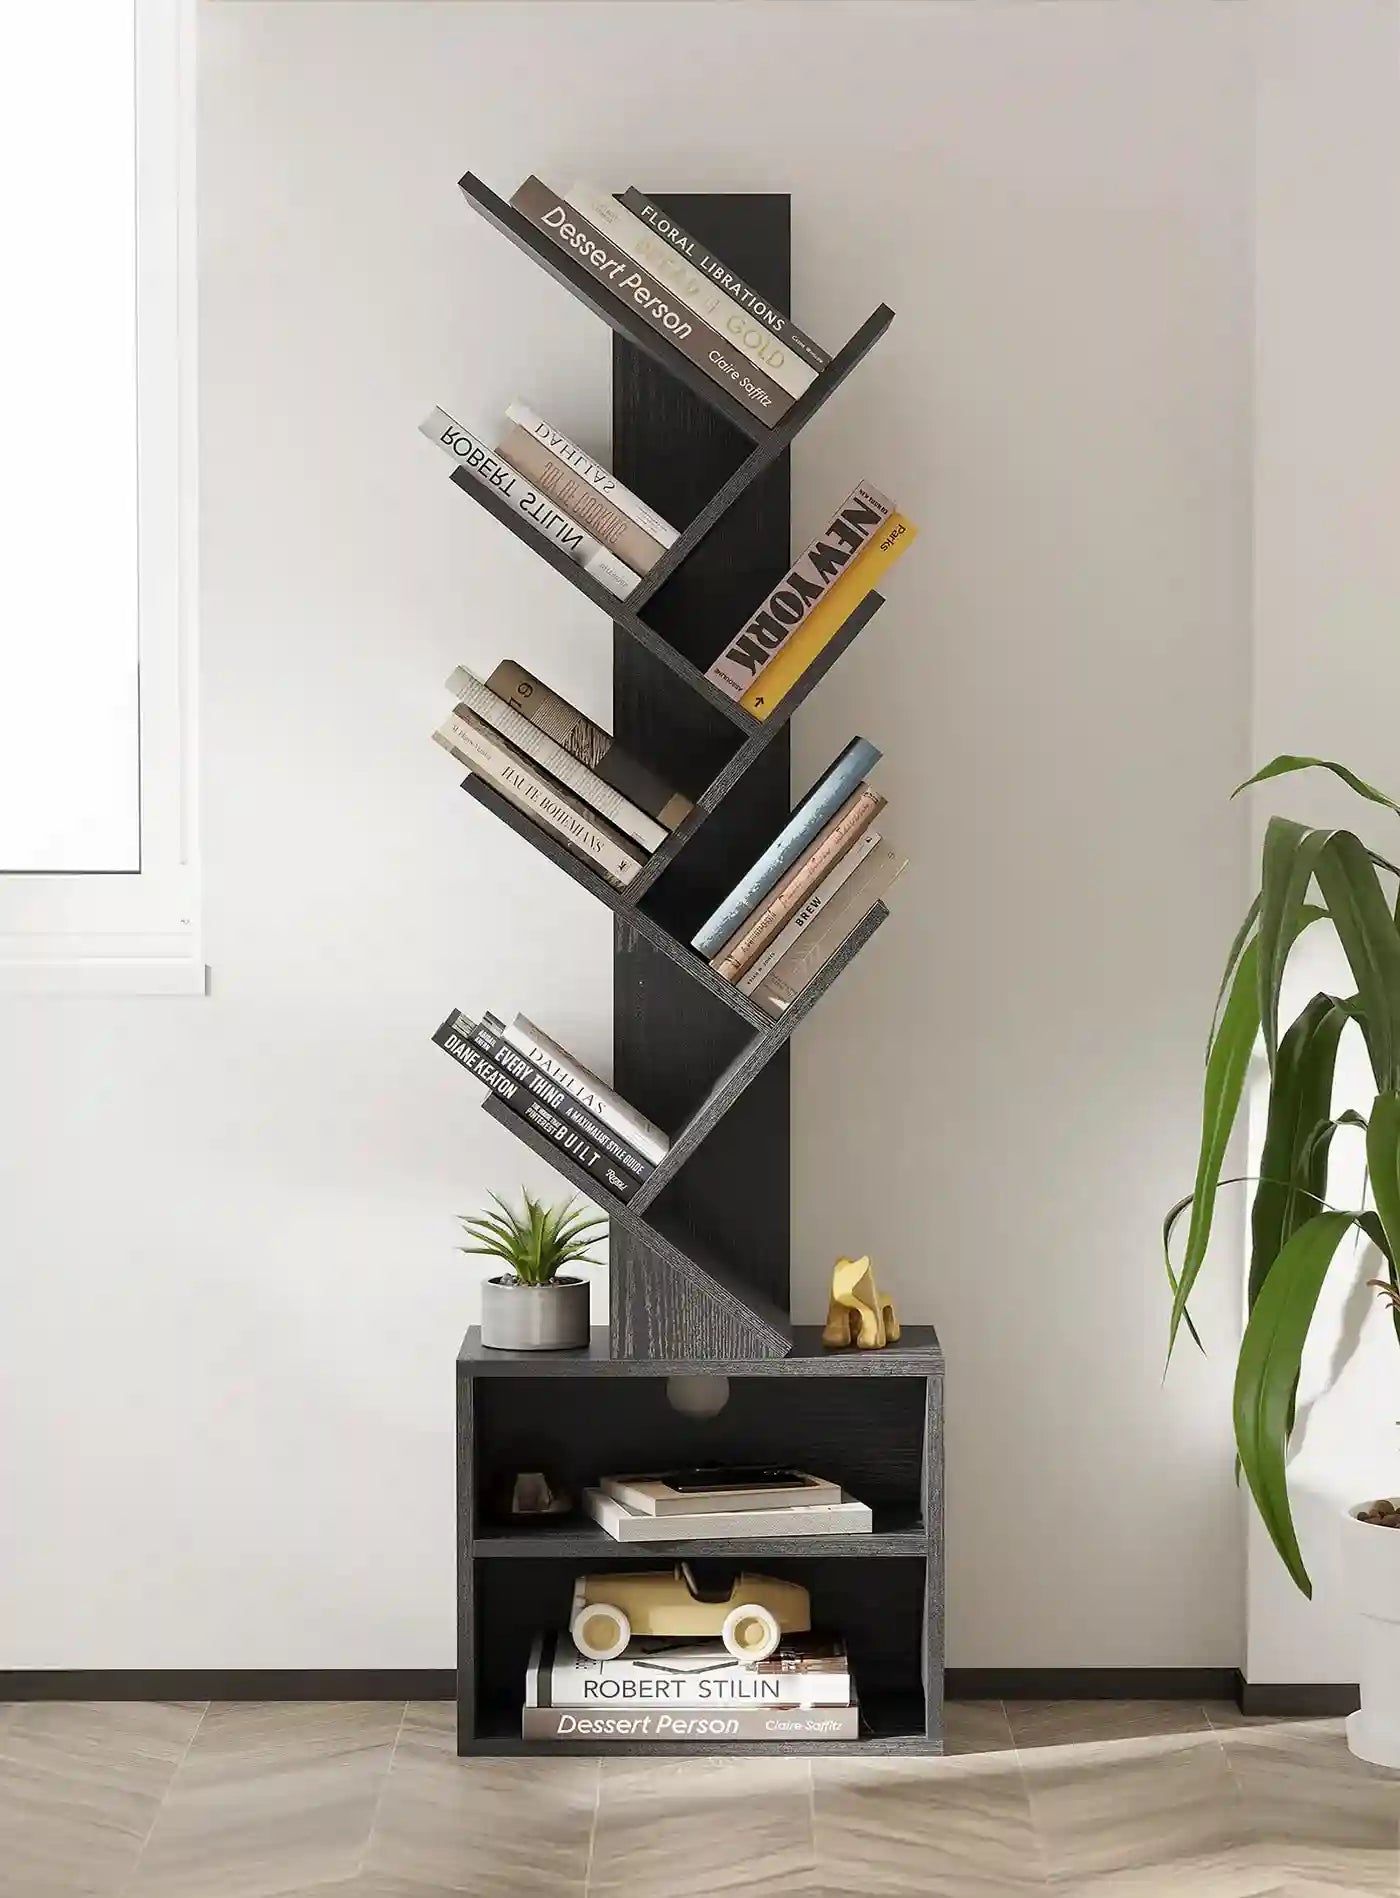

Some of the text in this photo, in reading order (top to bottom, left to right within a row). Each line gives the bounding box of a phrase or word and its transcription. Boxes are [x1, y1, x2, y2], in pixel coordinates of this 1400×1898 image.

[541, 206, 692, 339] Dessert Person
[642, 206, 784, 330] FLORAL LIBRATIONS
[725, 314, 786, 369] GOLD
[709, 351, 772, 407] Claire Saffitz
[880, 524, 906, 551] Parks
[726, 497, 882, 676] NEW YORK
[501, 766, 604, 853] HAUTE BOHEMIANS
[795, 896, 821, 926] BREW
[444, 1034, 518, 1098] DIANE KEATON
[495, 1046, 564, 1108] EVERY THING
[529, 1048, 606, 1114] DAHLIAS
[525, 1107, 557, 1135] PINTEREST
[554, 1126, 600, 1166] BUILT
[566, 1107, 644, 1175] A MAXIMALIST STYLE GUIDE
[584, 1680, 780, 1698] ROBERT STILIN
[557, 1714, 740, 1734] Dessert Person
[766, 1720, 844, 1733] Claire Saffitz
